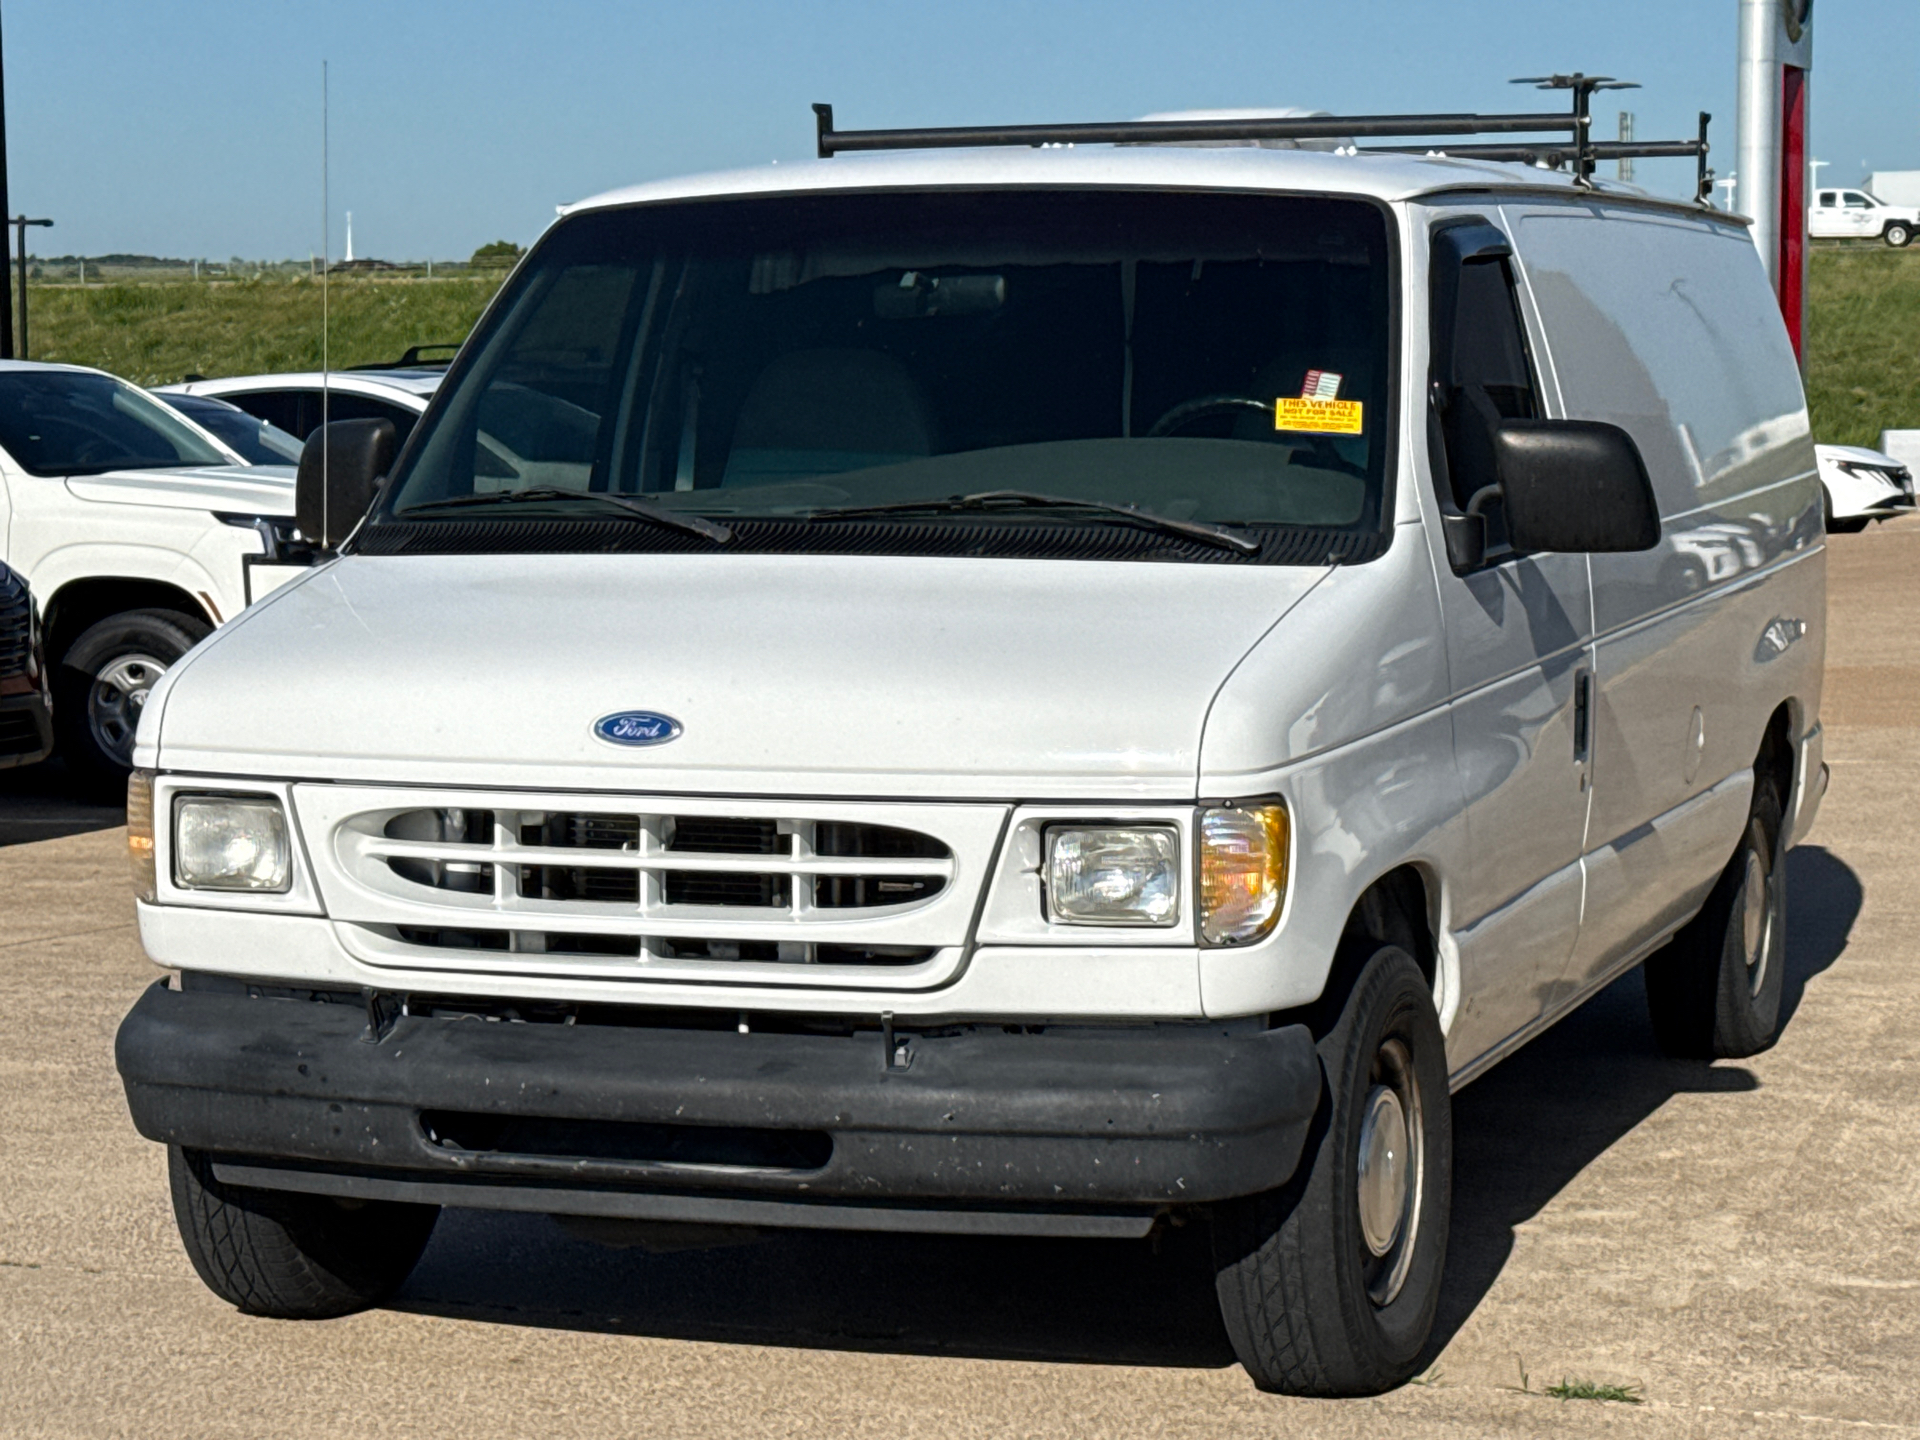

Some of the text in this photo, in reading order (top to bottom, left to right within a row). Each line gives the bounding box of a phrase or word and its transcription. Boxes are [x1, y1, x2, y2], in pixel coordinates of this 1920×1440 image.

[1283, 400, 1357, 411] THIS VEHICLE
[613, 717, 662, 737] Ford
